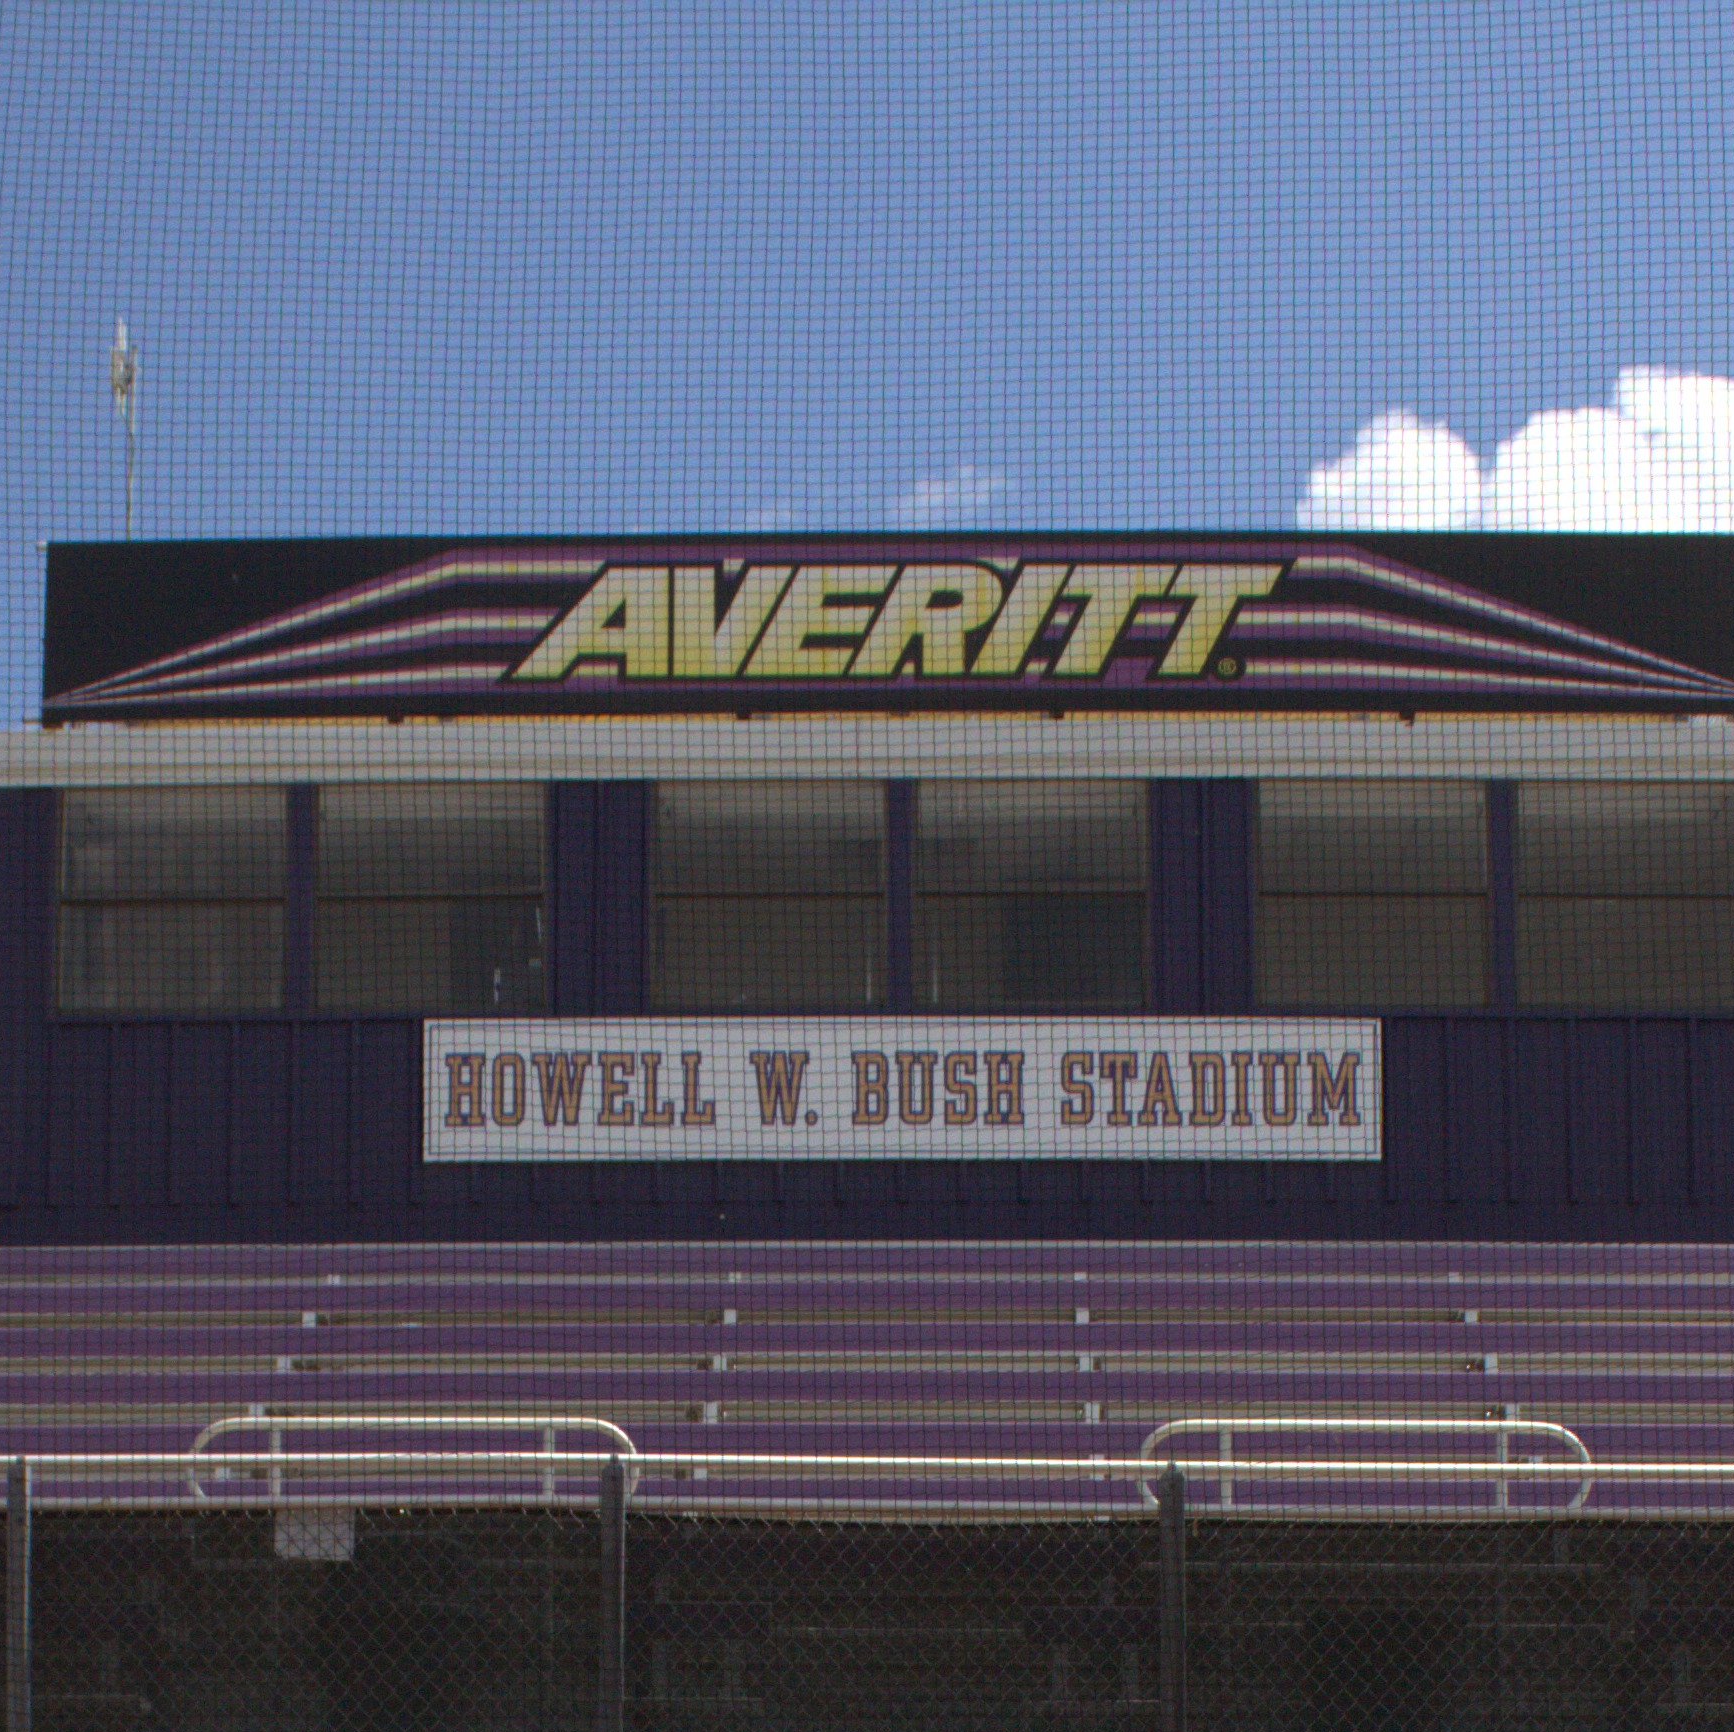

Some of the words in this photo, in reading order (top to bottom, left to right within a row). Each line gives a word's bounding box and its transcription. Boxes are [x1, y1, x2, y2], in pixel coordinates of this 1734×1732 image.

[504, 562, 1288, 679] AVERITT
[444, 1050, 717, 1128] HOWELL
[749, 1050, 819, 1127] W.
[851, 1049, 1026, 1127] BUSH
[1060, 1050, 1362, 1128] STADIUM
